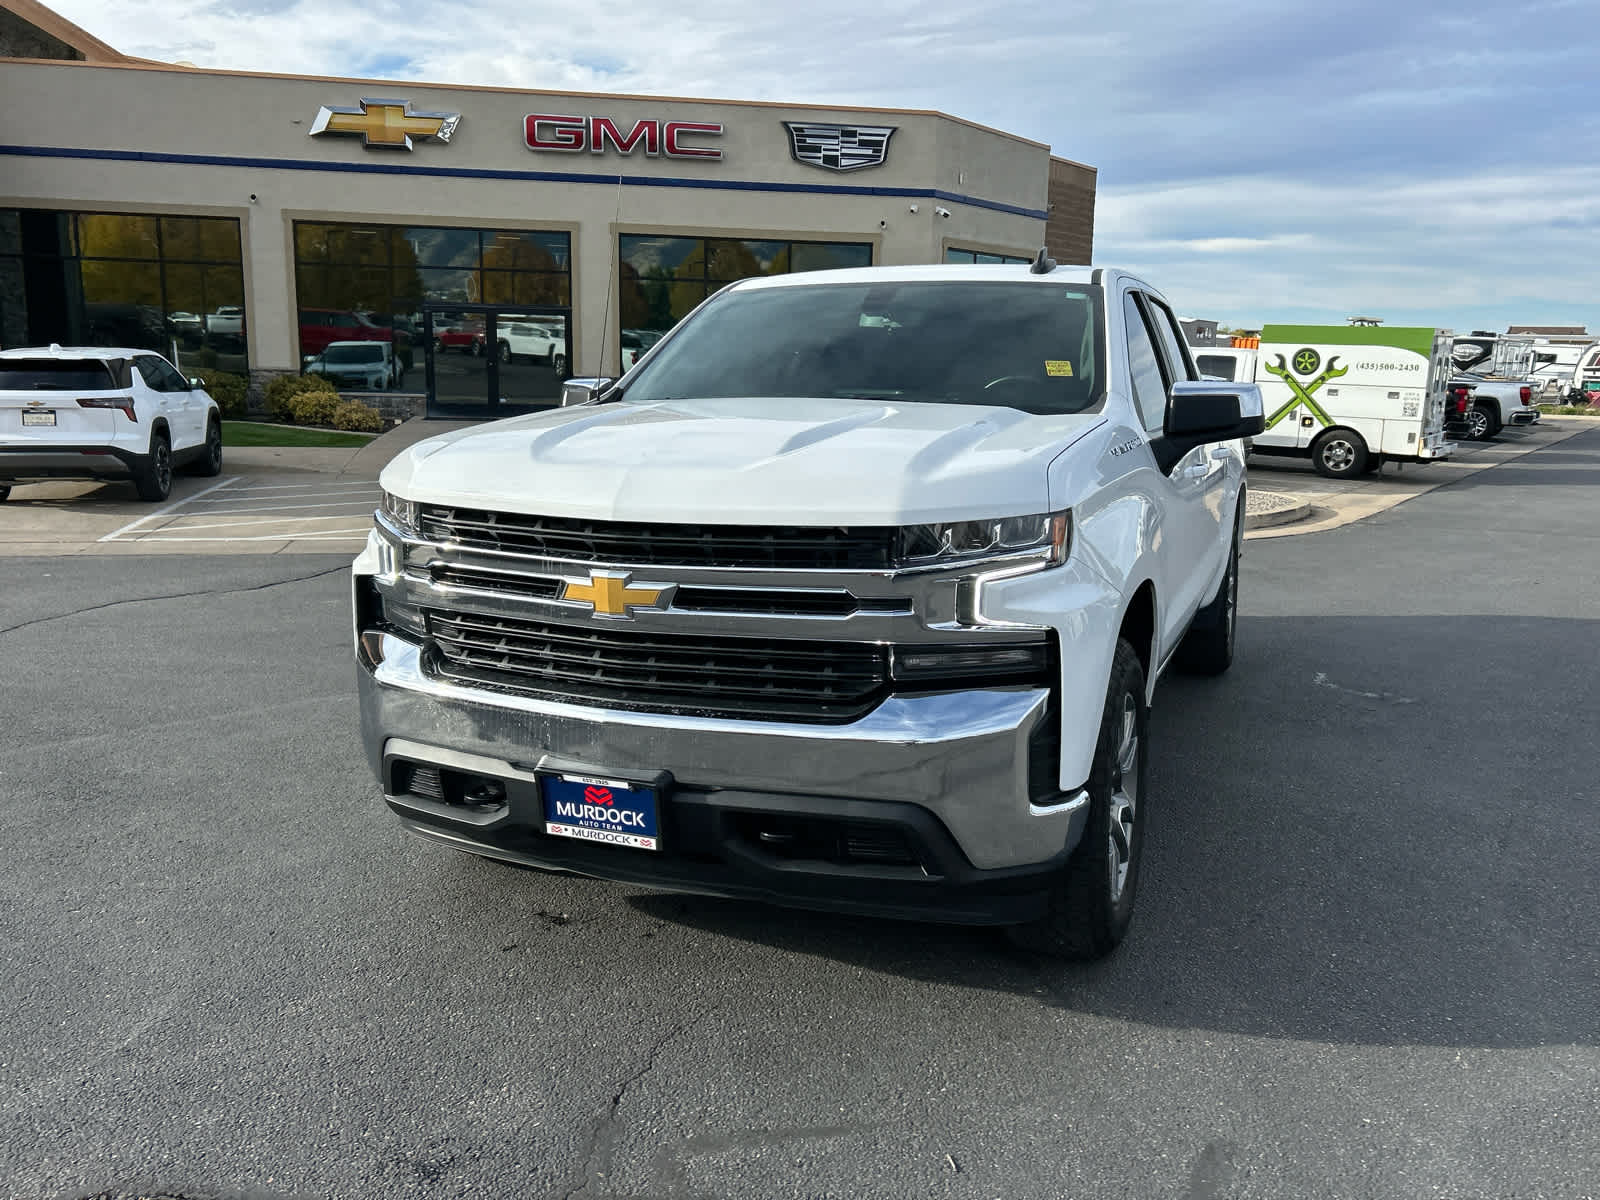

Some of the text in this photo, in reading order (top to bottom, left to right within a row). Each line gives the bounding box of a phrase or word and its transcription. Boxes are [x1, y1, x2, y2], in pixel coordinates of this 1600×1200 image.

[524, 114, 723, 160] GMC
[1356, 363, 1420, 371] (435)500-2430
[556, 801, 645, 827] MURDOCK
[579, 820, 622, 831] AUTO TEAM
[572, 828, 631, 844] MURDOCK
